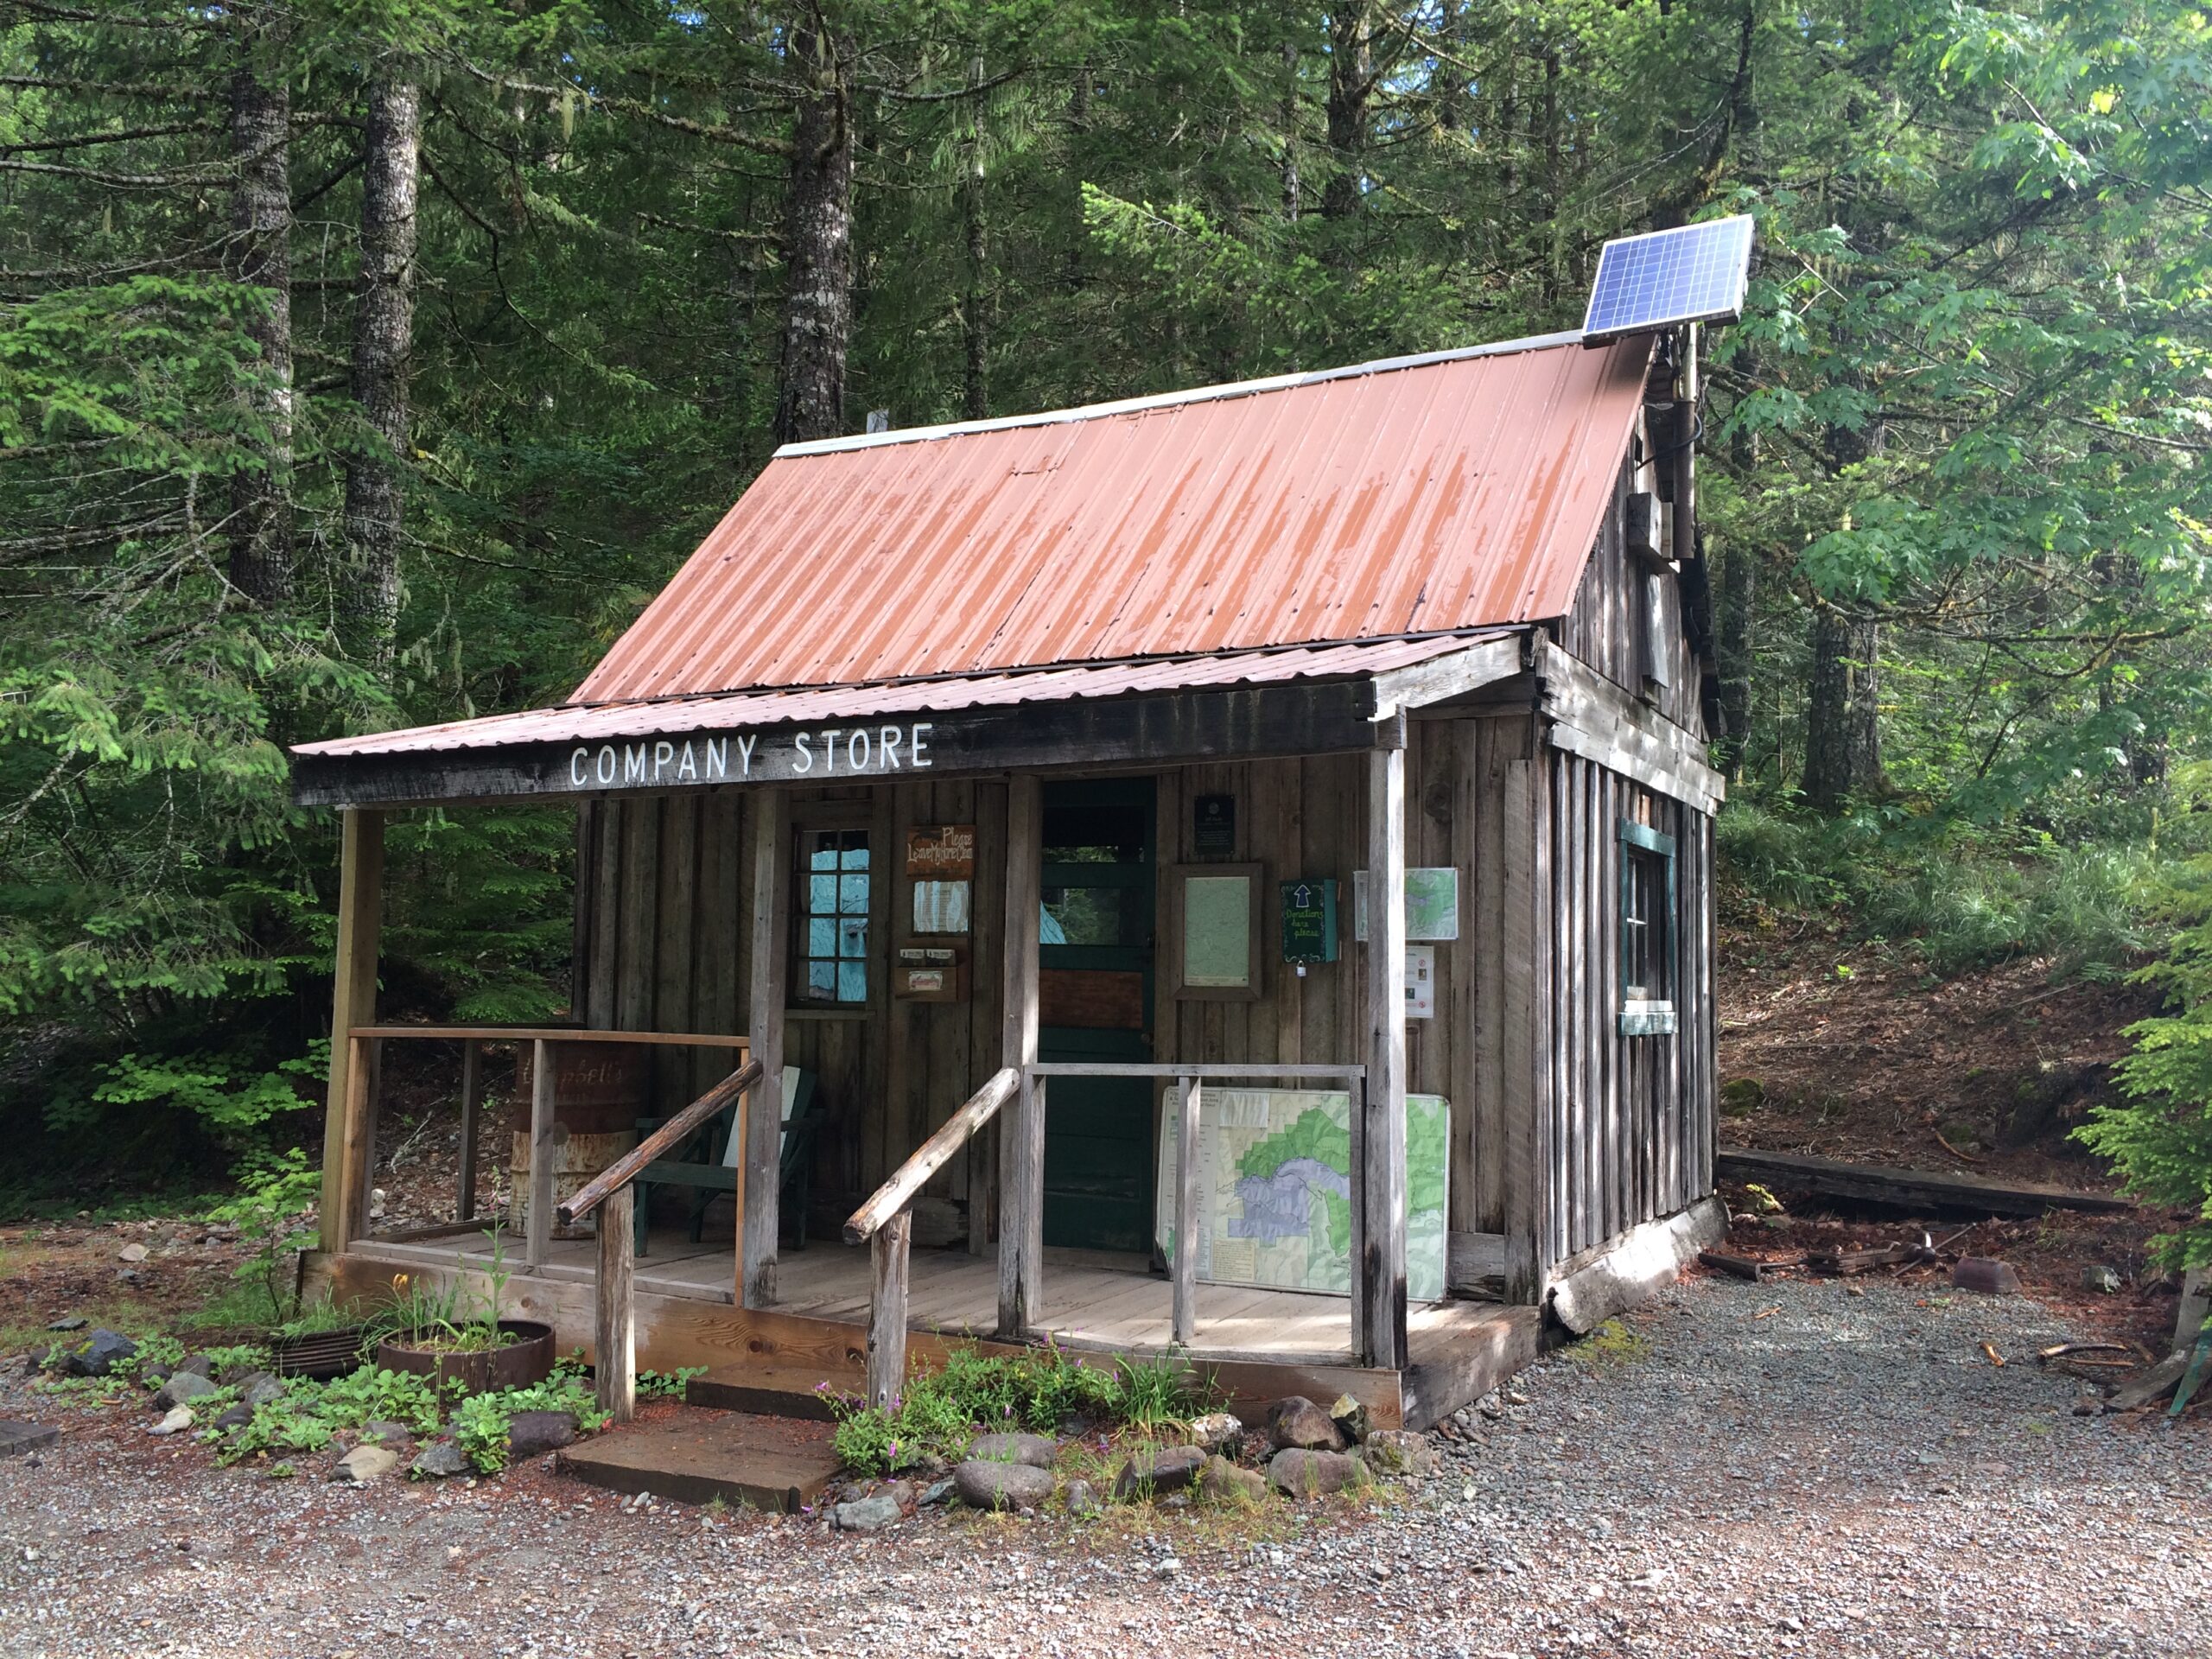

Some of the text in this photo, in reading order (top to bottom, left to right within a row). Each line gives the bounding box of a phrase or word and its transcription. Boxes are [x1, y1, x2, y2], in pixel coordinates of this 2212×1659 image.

[571, 723, 933, 786] COMPANY STORE
[942, 826, 973, 848] Please
[907, 842, 931, 863] Leave
[931, 842, 941, 866] My
[1286, 908, 1324, 919] Donations
